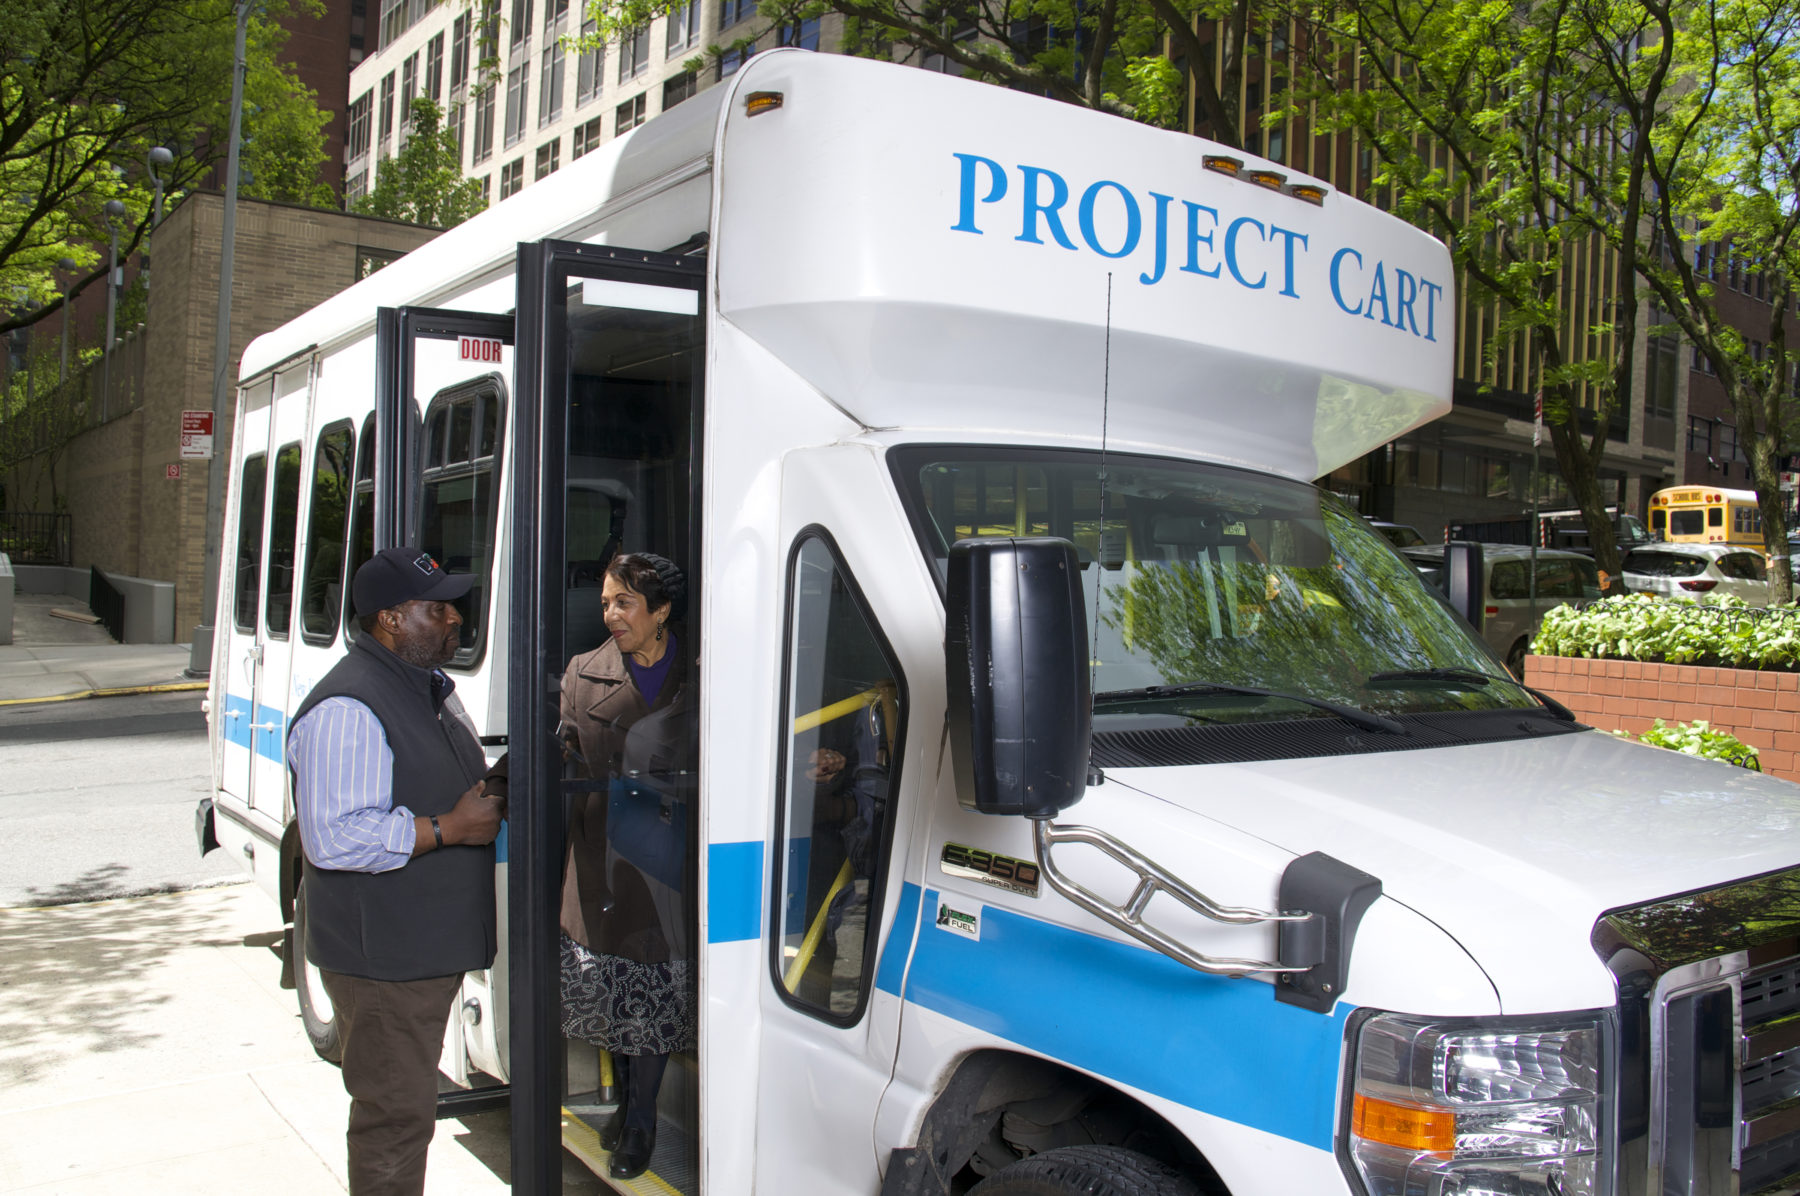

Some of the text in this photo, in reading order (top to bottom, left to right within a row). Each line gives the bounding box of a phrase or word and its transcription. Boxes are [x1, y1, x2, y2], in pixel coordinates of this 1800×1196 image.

[950, 152, 1443, 343] PROJECT CART
[461, 338, 501, 362] DOOR
[1672, 493, 1689, 501] SCHOOL
[982, 876, 1035, 896] SUPER DUTY
[951, 920, 974, 933] FUEL
